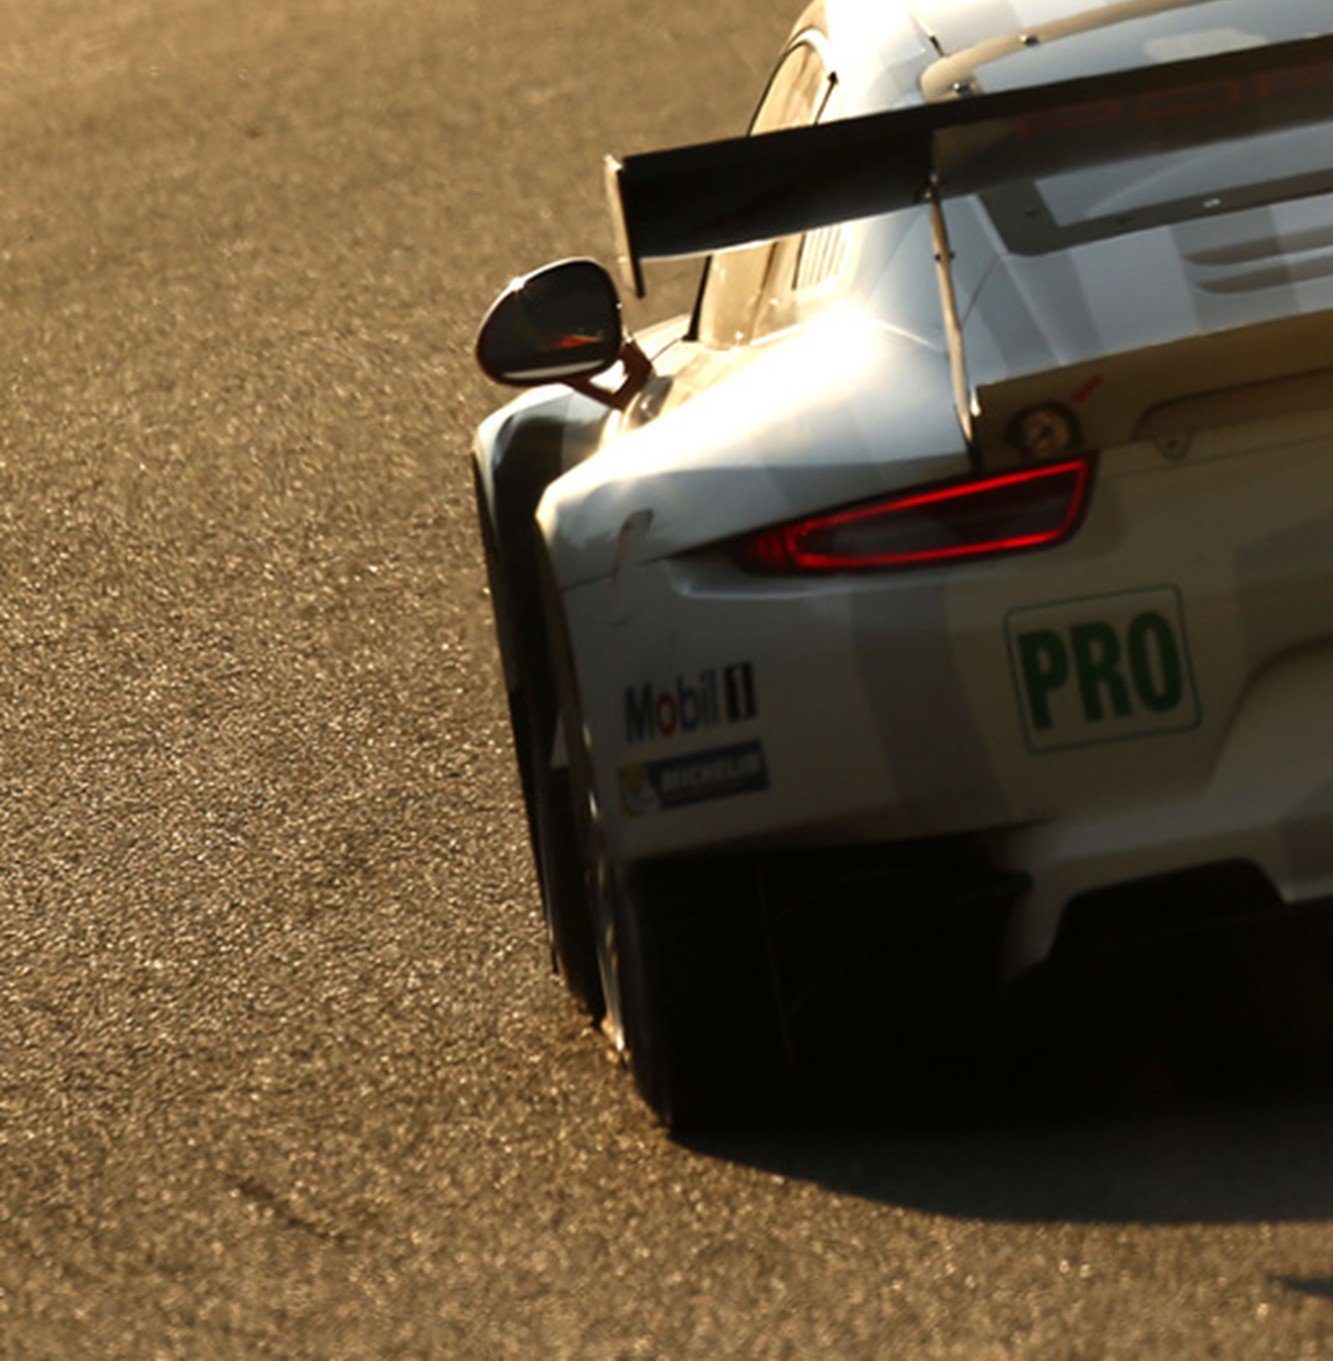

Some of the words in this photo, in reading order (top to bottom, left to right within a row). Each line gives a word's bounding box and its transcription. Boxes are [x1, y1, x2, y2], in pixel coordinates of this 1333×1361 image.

[625, 668, 720, 744] Mobil
[728, 662, 754, 721] 1
[1017, 609, 1184, 731] PRO
[661, 751, 759, 794] MICHELIN
